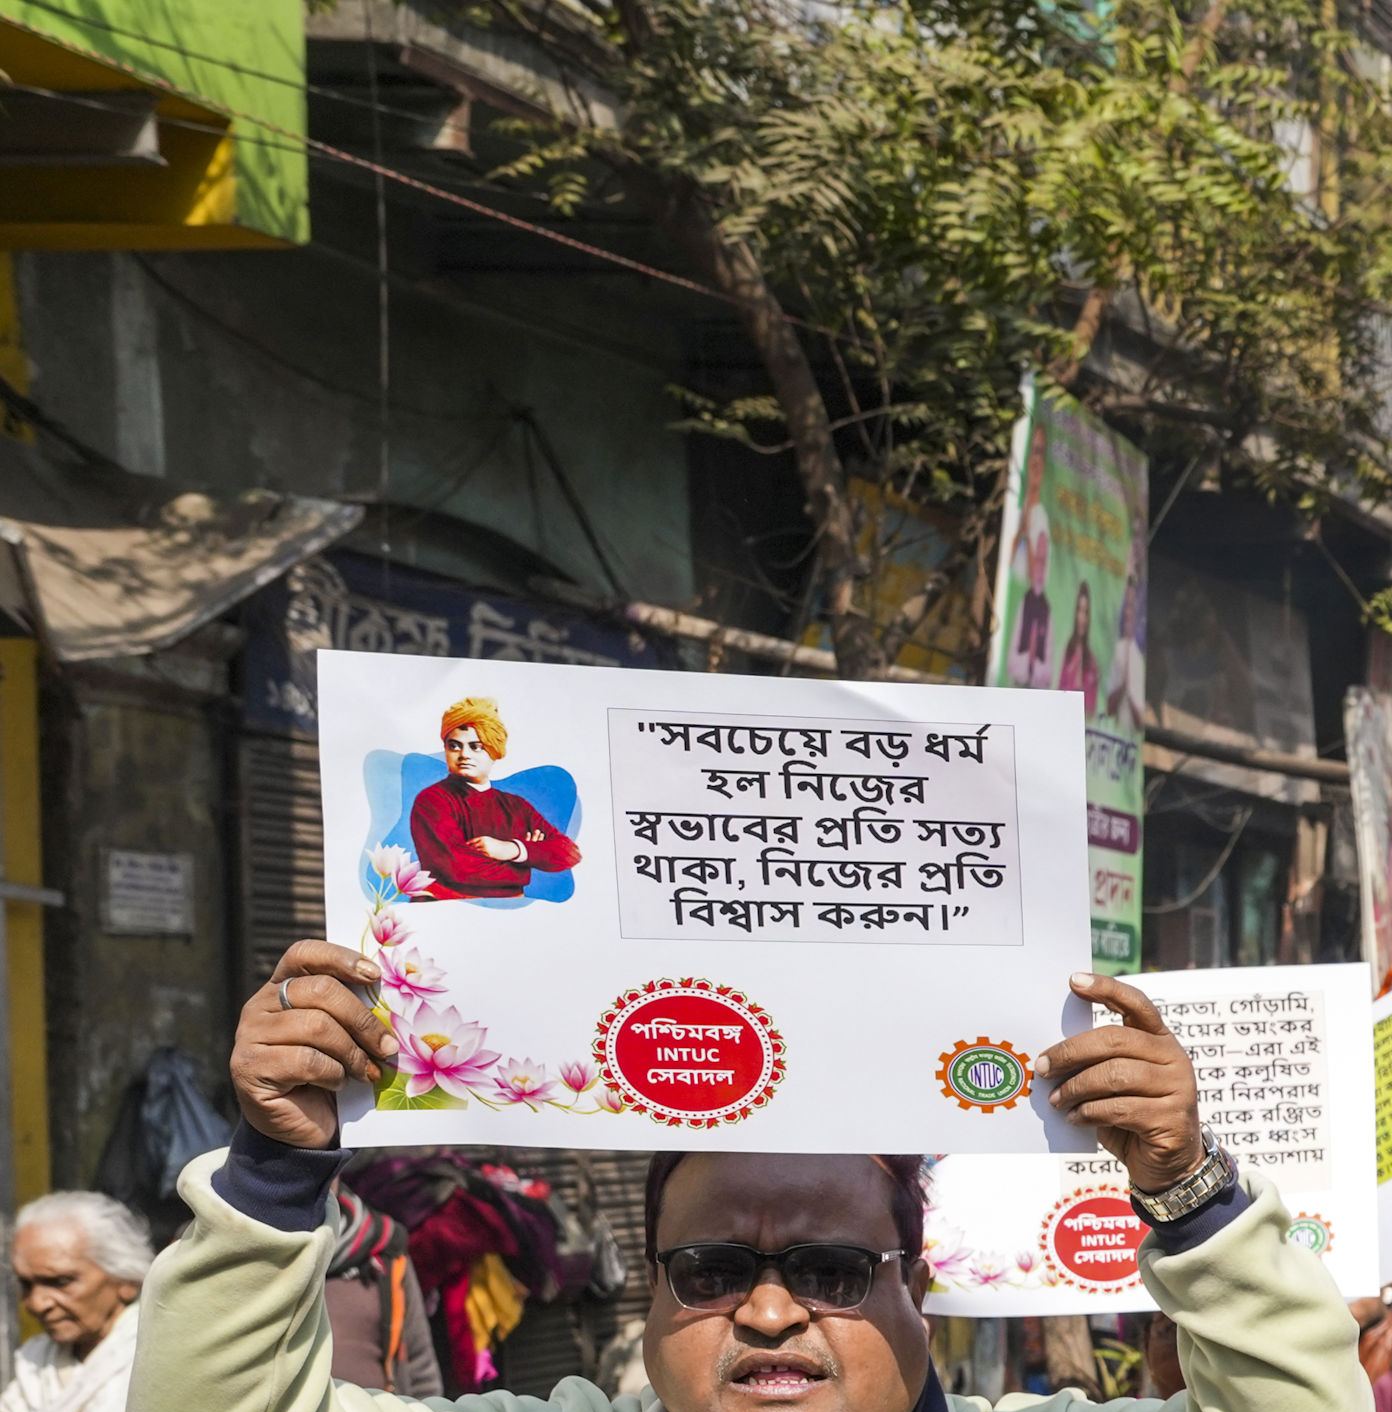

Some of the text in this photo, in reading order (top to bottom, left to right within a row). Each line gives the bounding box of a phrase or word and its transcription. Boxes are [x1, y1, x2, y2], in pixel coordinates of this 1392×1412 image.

[841, 730, 912, 767] বড়
[925, 724, 991, 763] ধর্ম
[701, 760, 929, 805] হল নিজের
[626, 806, 1005, 850] স্বভাবের প্রতি সত্য
[634, 847, 1006, 895] থাকা, নিজের প্রতি
[669, 887, 804, 933] বিশ্বাস
[631, 1018, 743, 1044] পশ্চিমবঙ্গ
[1234, 1019, 1314, 1036] ভয়ংকর
[657, 1048, 720, 1062] INTUC
[1290, 1036, 1323, 1055] এই
[647, 1069, 735, 1085] সেবাদল
[969, 1062, 1003, 1088] INTUC
[1235, 1058, 1312, 1082] কলুষিত
[1232, 1083, 1321, 1101] নিরপরাধ
[1268, 1128, 1318, 1143] ধ্বংস
[1249, 1147, 1325, 1167] হতাশায়
[1081, 1233, 1126, 1247] INTUC
